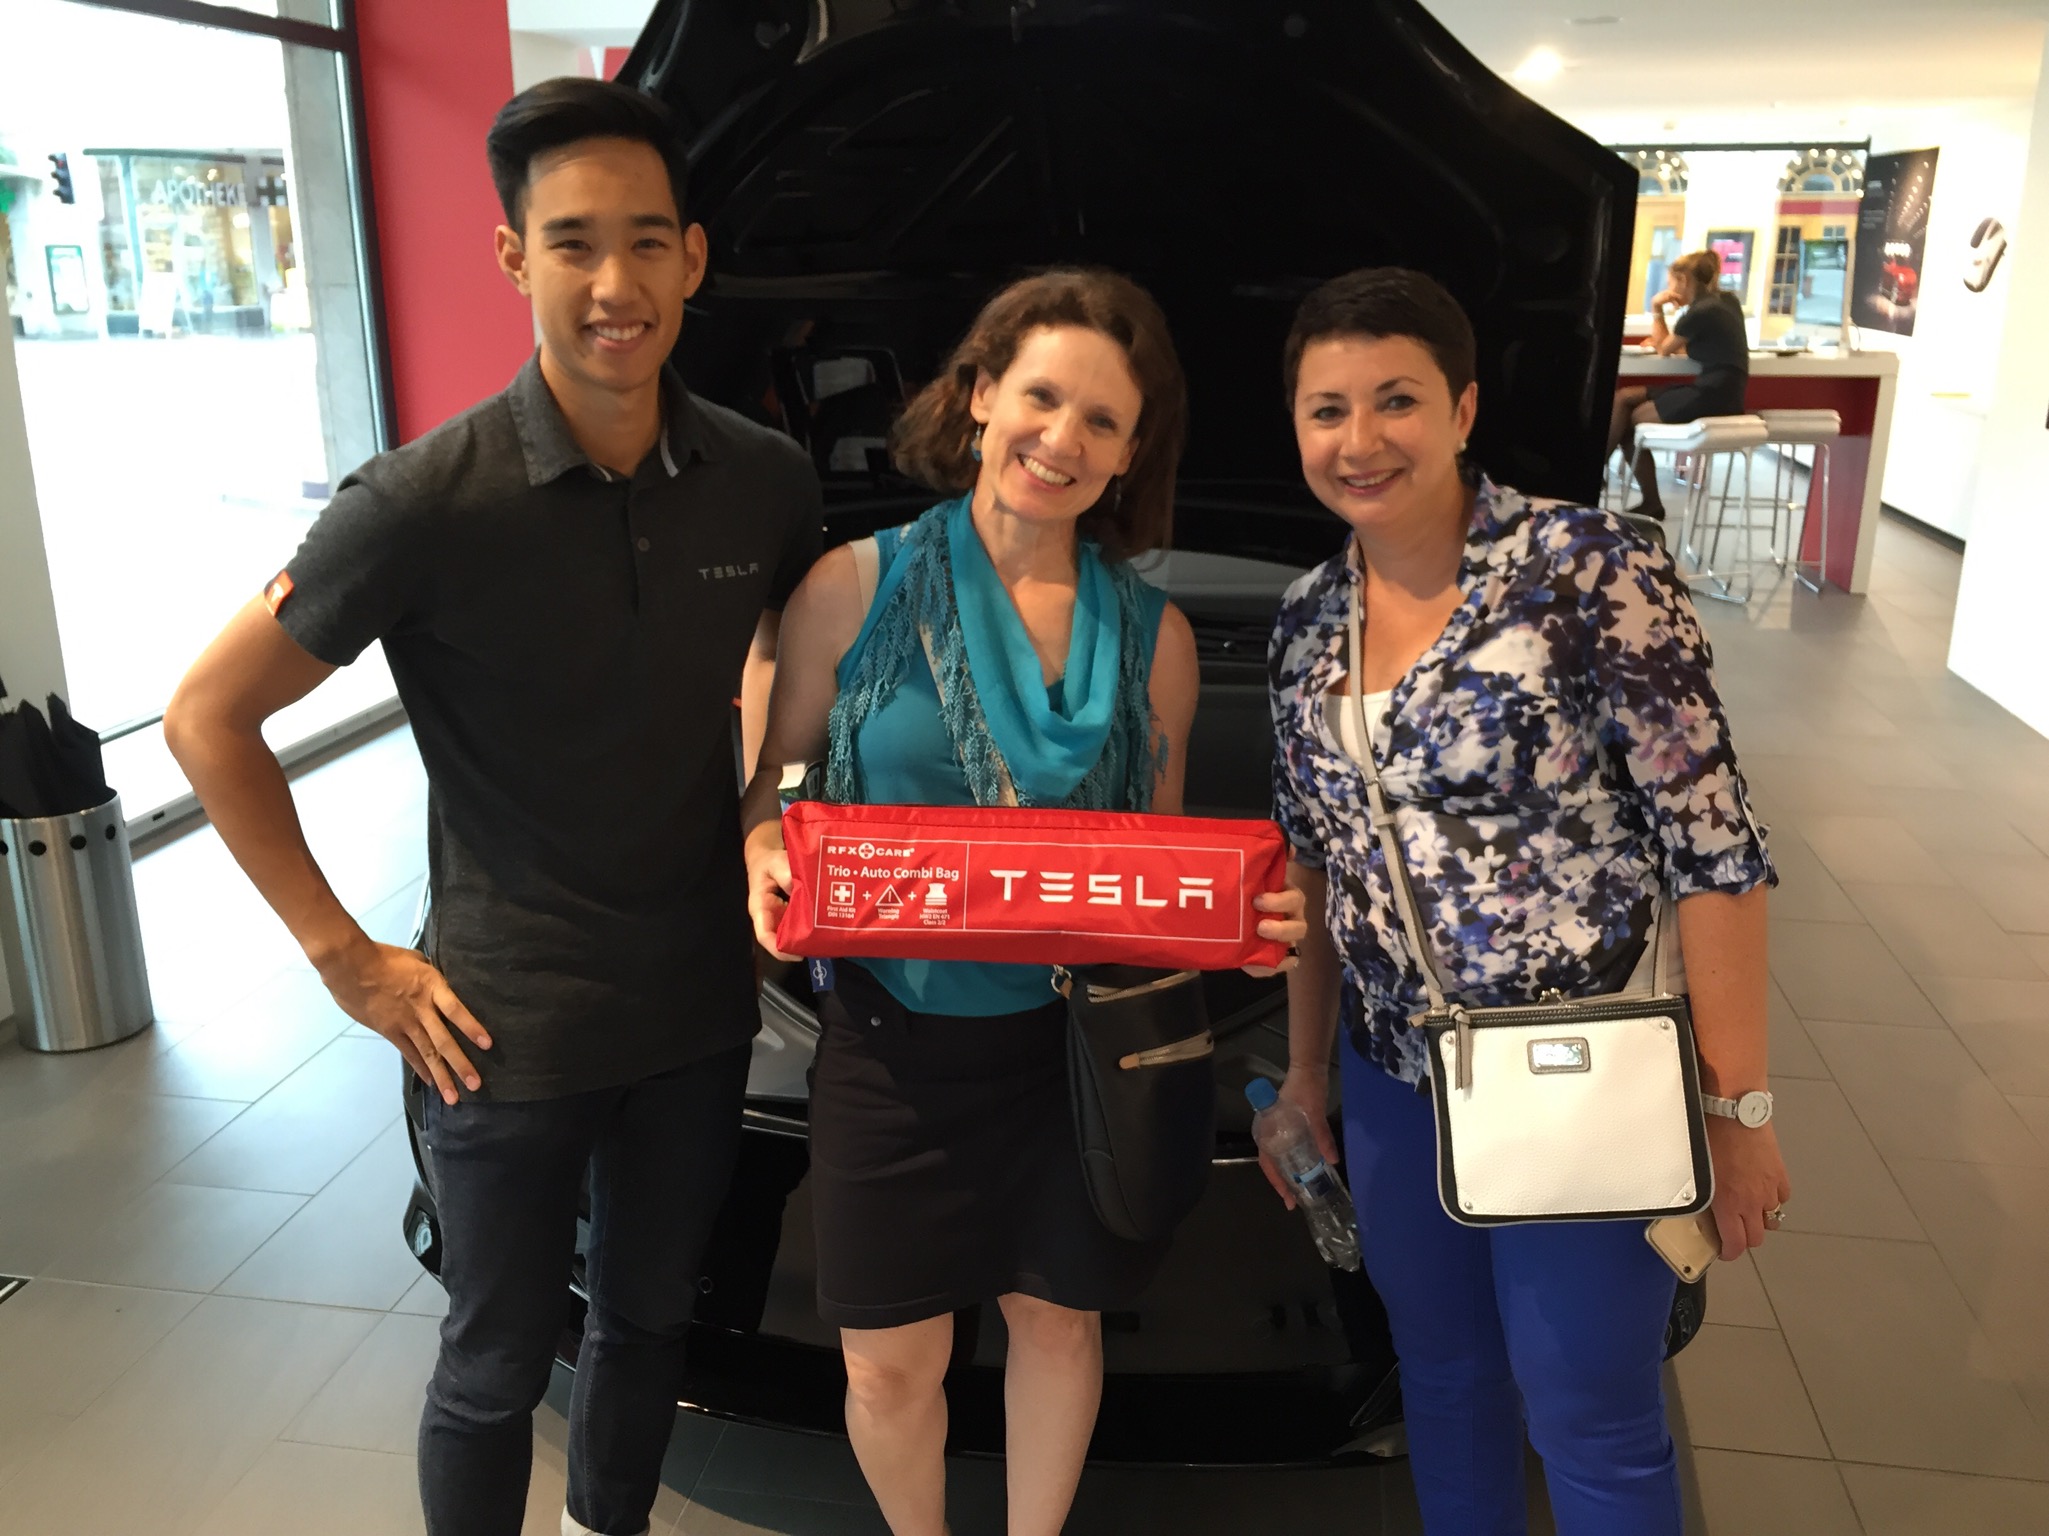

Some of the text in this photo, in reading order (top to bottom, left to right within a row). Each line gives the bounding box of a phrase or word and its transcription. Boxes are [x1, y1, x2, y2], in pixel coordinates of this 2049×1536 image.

[150, 178, 247, 207] APOTHEKE
[698, 562, 759, 580] TESLA
[827, 845, 858, 855] RFX
[827, 864, 959, 882] Trio Auto Combi Bag
[989, 869, 1214, 910] TESLA
